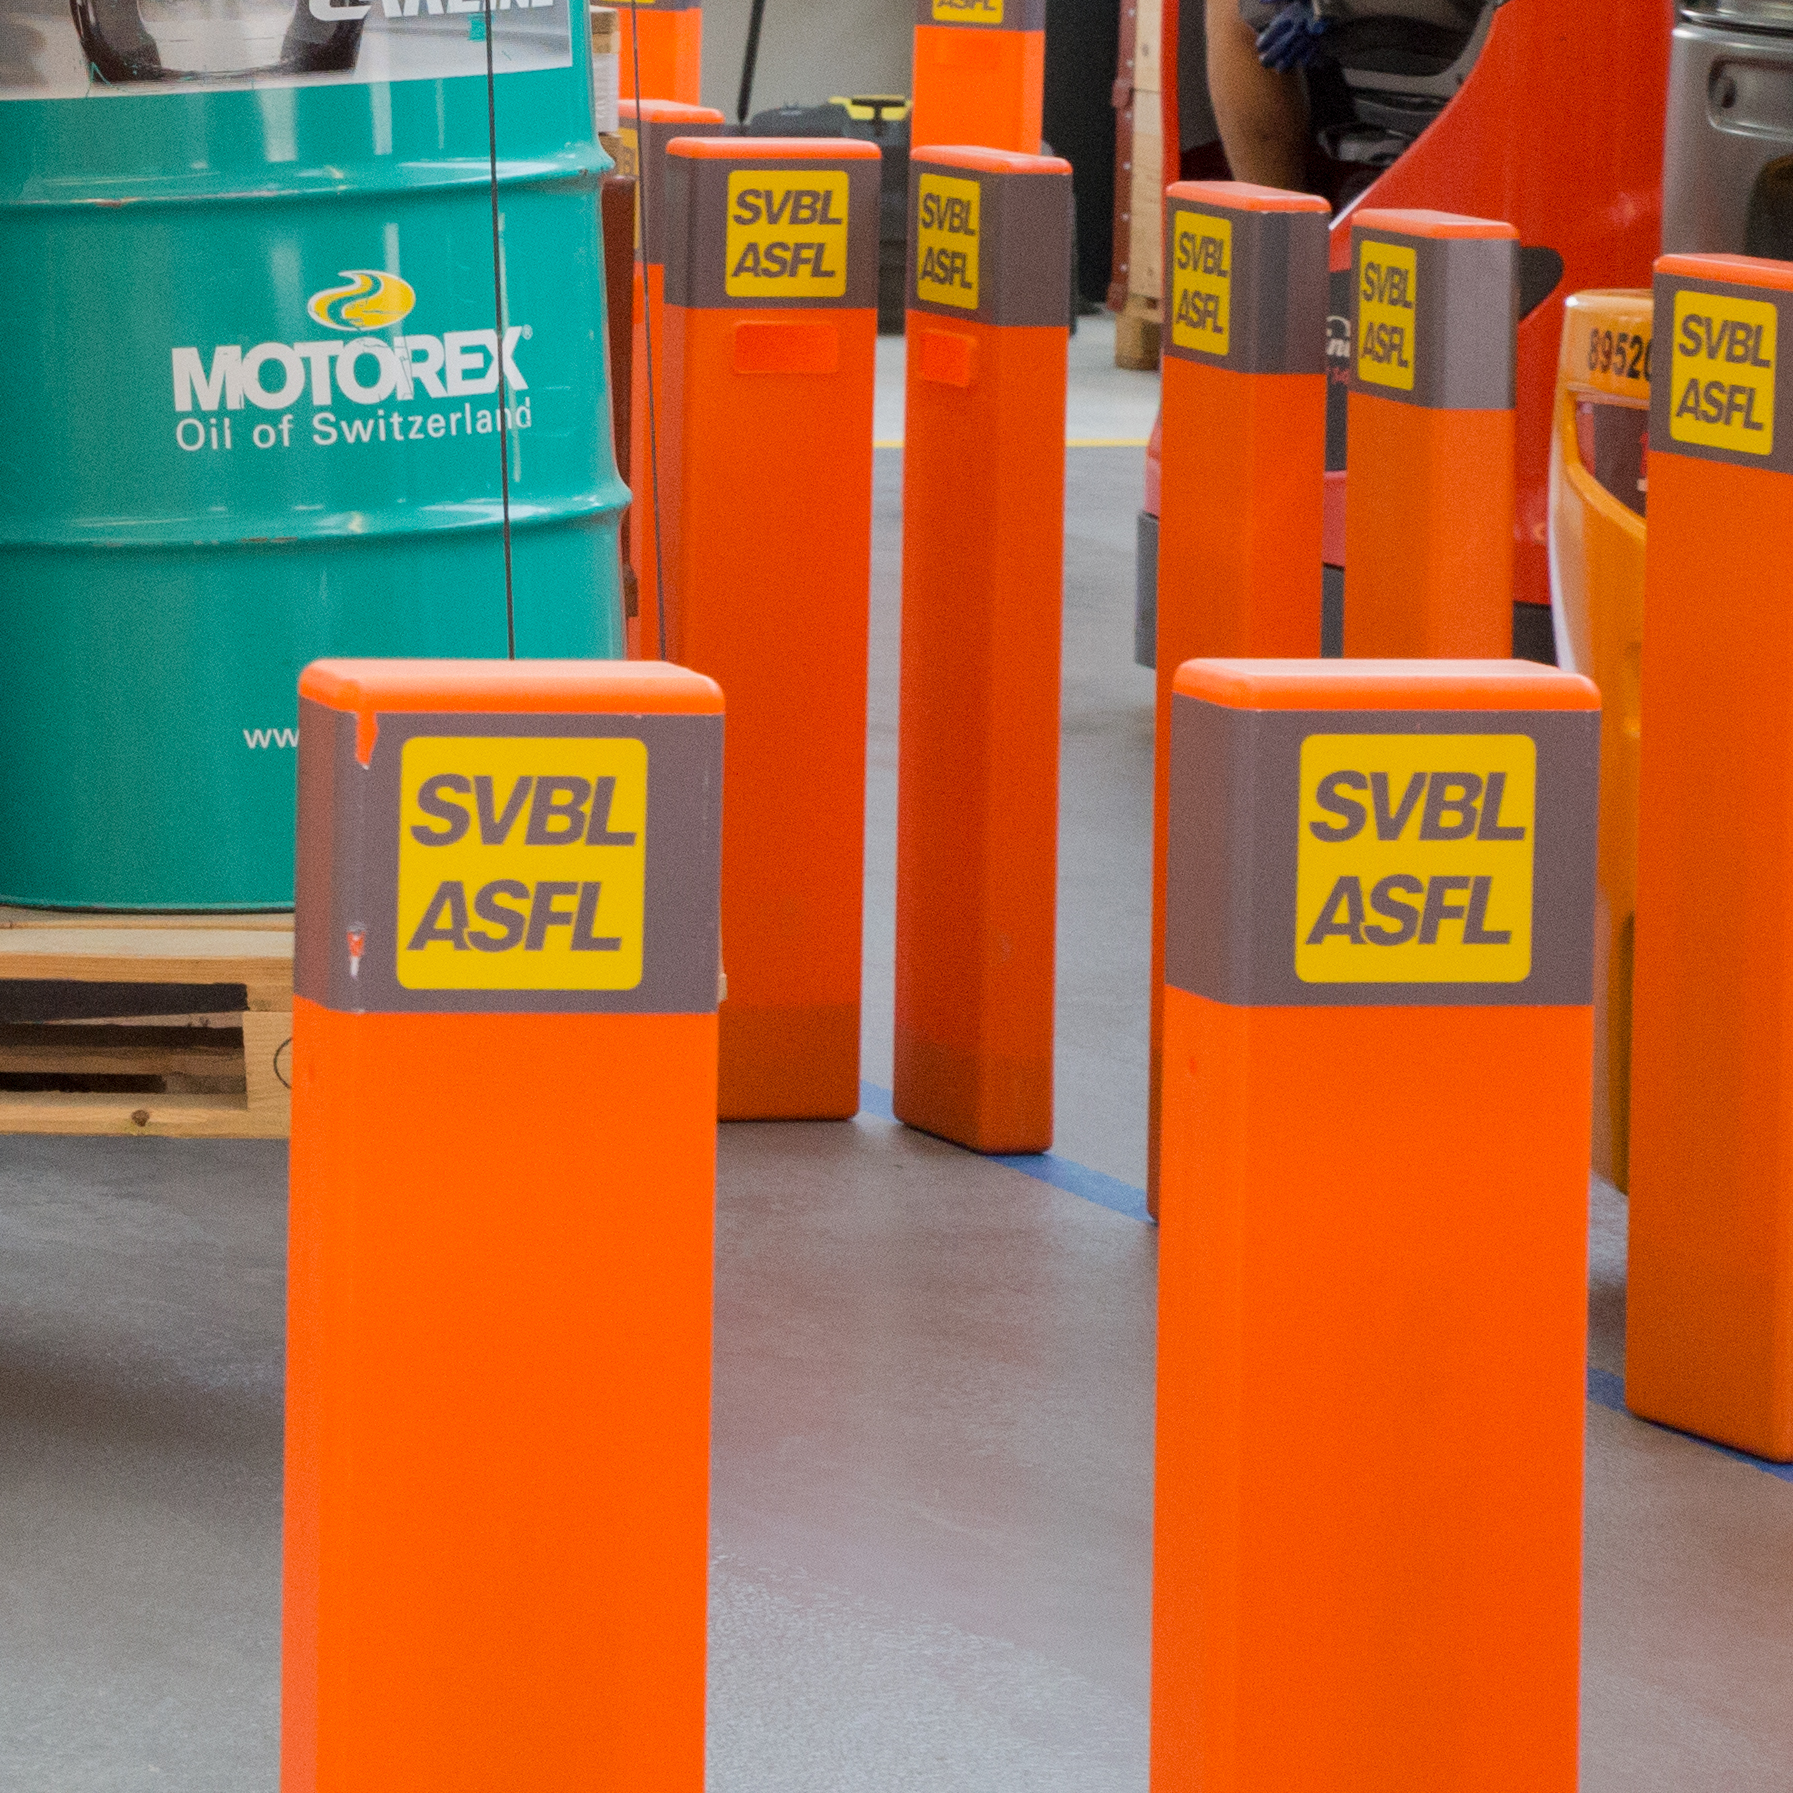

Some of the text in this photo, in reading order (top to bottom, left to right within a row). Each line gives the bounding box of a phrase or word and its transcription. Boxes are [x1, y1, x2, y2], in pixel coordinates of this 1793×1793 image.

[733, 188, 844, 226] SVBL
[921, 192, 976, 237] SVBL
[732, 241, 835, 278] ASFL
[919, 246, 973, 290] ASFL
[1176, 230, 1228, 279] SVBL
[1175, 288, 1224, 335] ASFL
[1362, 262, 1413, 310] SVBL
[1361, 321, 1410, 369] ASFL
[1678, 313, 1771, 369] SVBL
[171, 326, 529, 413] MOTOREX
[176, 398, 532, 451] Oil of Switzerland
[1675, 378, 1764, 432] ASFL
[411, 773, 636, 847] SVBL
[1309, 770, 1525, 842] SVBL
[407, 879, 621, 953] ASFL
[1306, 874, 1511, 946] ASFL
